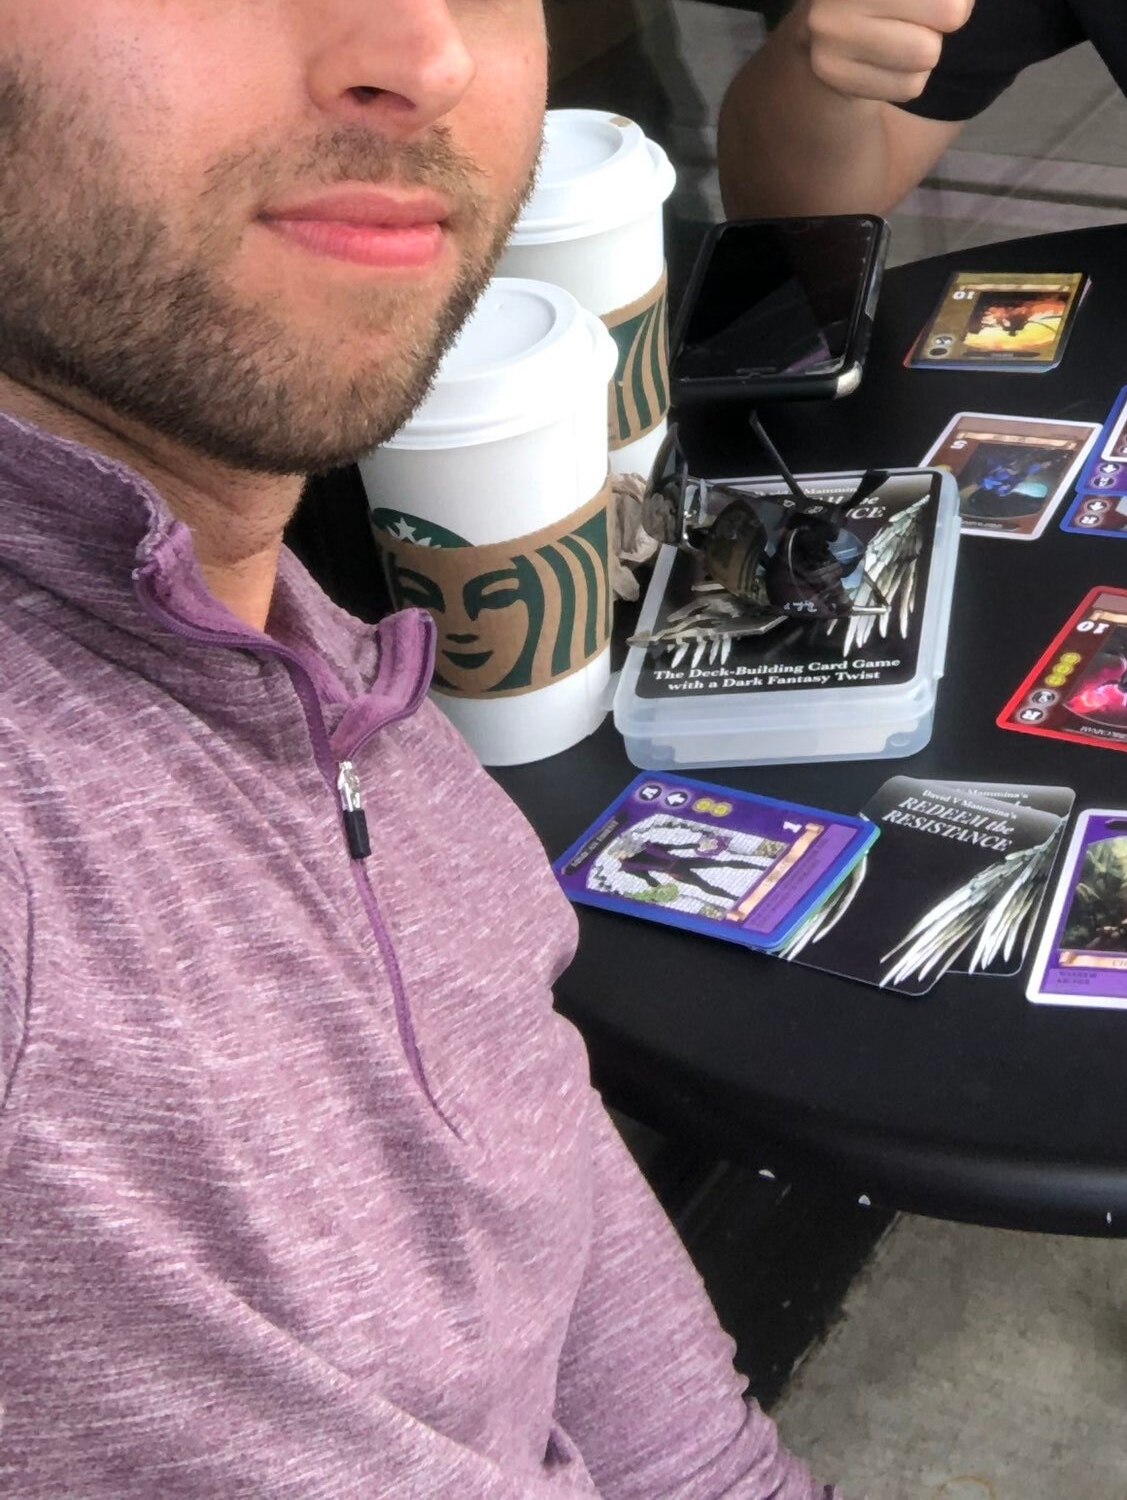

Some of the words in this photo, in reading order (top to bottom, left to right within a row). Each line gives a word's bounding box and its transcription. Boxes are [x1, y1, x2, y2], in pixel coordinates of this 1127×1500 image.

[1076, 620, 1109, 634] 10
[654, 669, 684, 680] The
[688, 663, 804, 679] Deck-Building
[808, 660, 848, 672] Card
[852, 658, 901, 669] Game
[668, 679, 704, 691] with
[722, 677, 763, 688] Dark
[767, 672, 831, 685] Fantasy
[836, 669, 881, 681] Twist
[922, 789, 951, 803] David
[783, 819, 803, 834] 1
[898, 797, 982, 828] REDEEM
[985, 818, 1016, 835] the
[882, 809, 1013, 852] RESISTANCE
